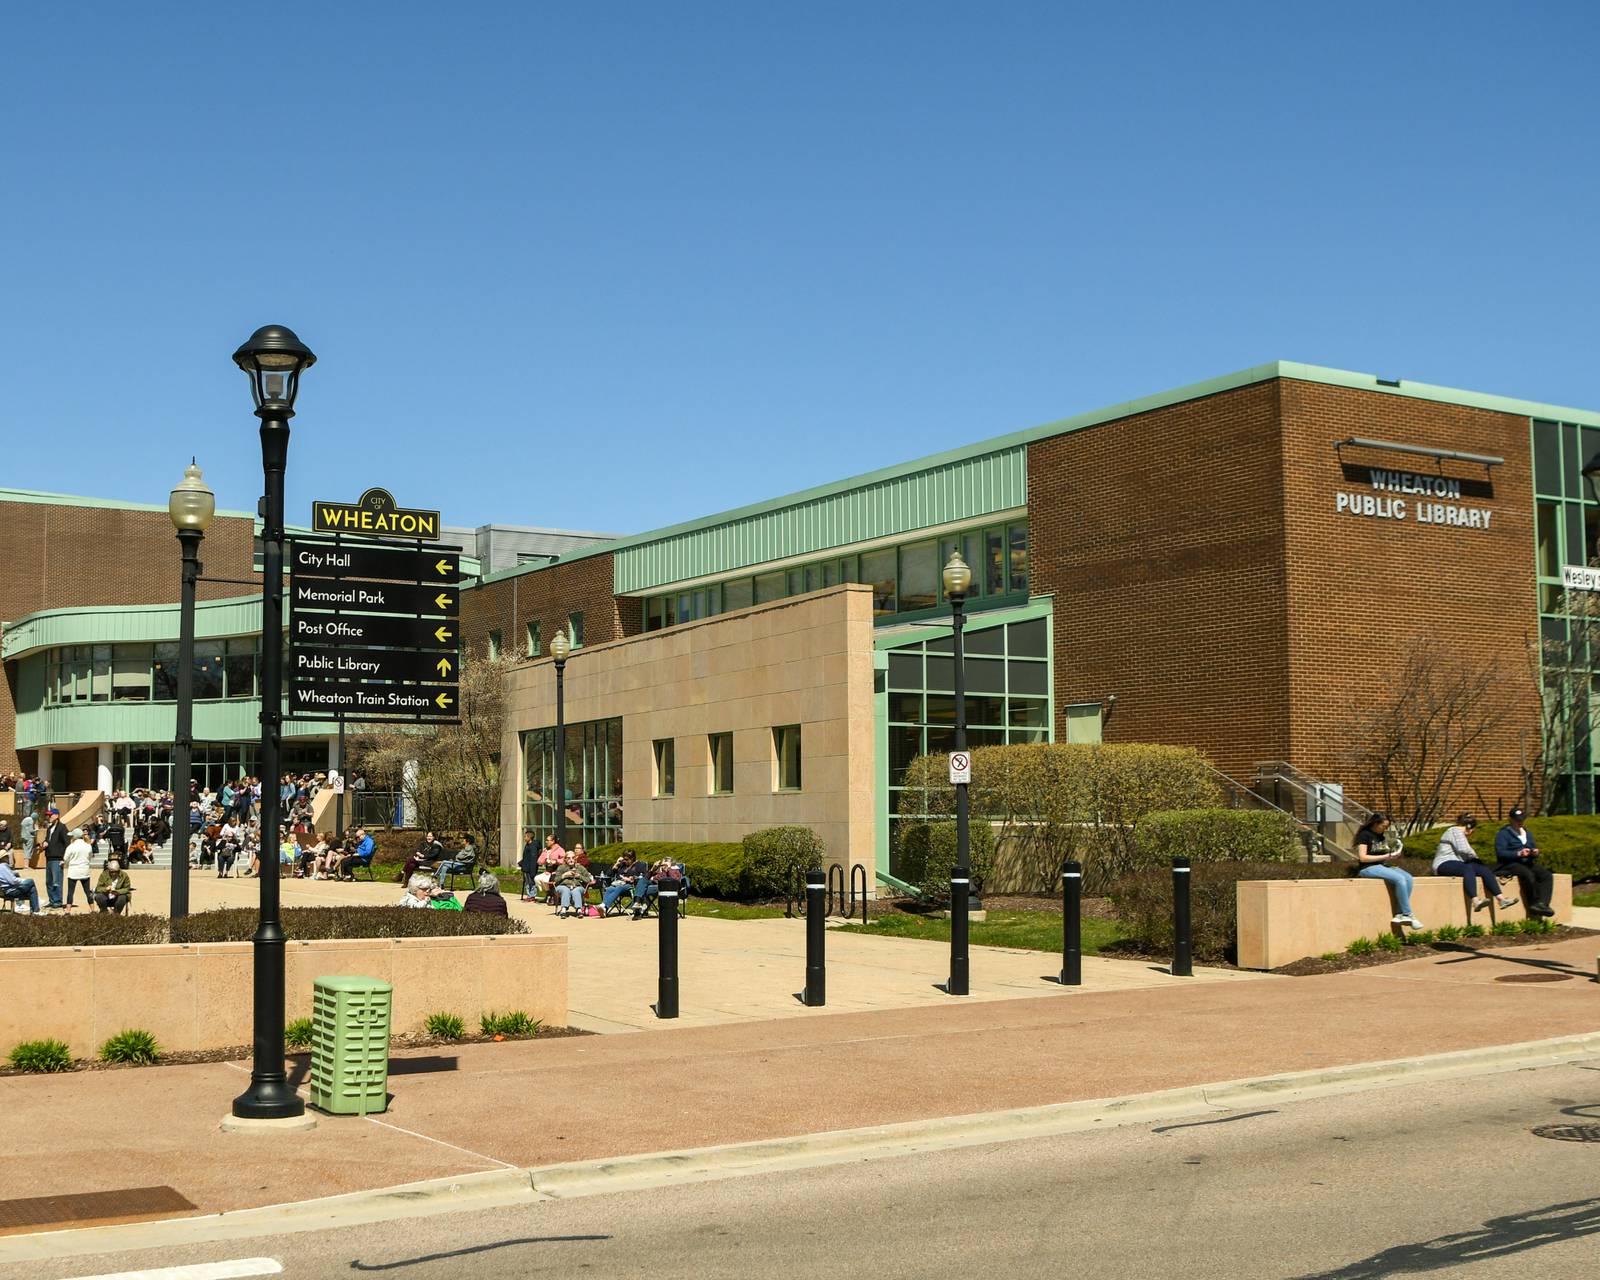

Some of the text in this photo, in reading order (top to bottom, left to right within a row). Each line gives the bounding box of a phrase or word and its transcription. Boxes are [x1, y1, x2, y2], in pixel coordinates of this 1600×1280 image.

[1370, 469, 1461, 499] WHEATON
[370, 497, 386, 505] CITY
[1336, 492, 1492, 529] PUBLIC LIBRARY
[322, 508, 433, 534] WHEATON
[299, 551, 350, 568] City Hall
[1564, 568, 1596, 589] Wesley
[298, 588, 385, 604] Memorial Park
[298, 621, 363, 637] Post Office
[298, 655, 380, 673] Public Library
[298, 689, 429, 707] Wheaton Train Station
